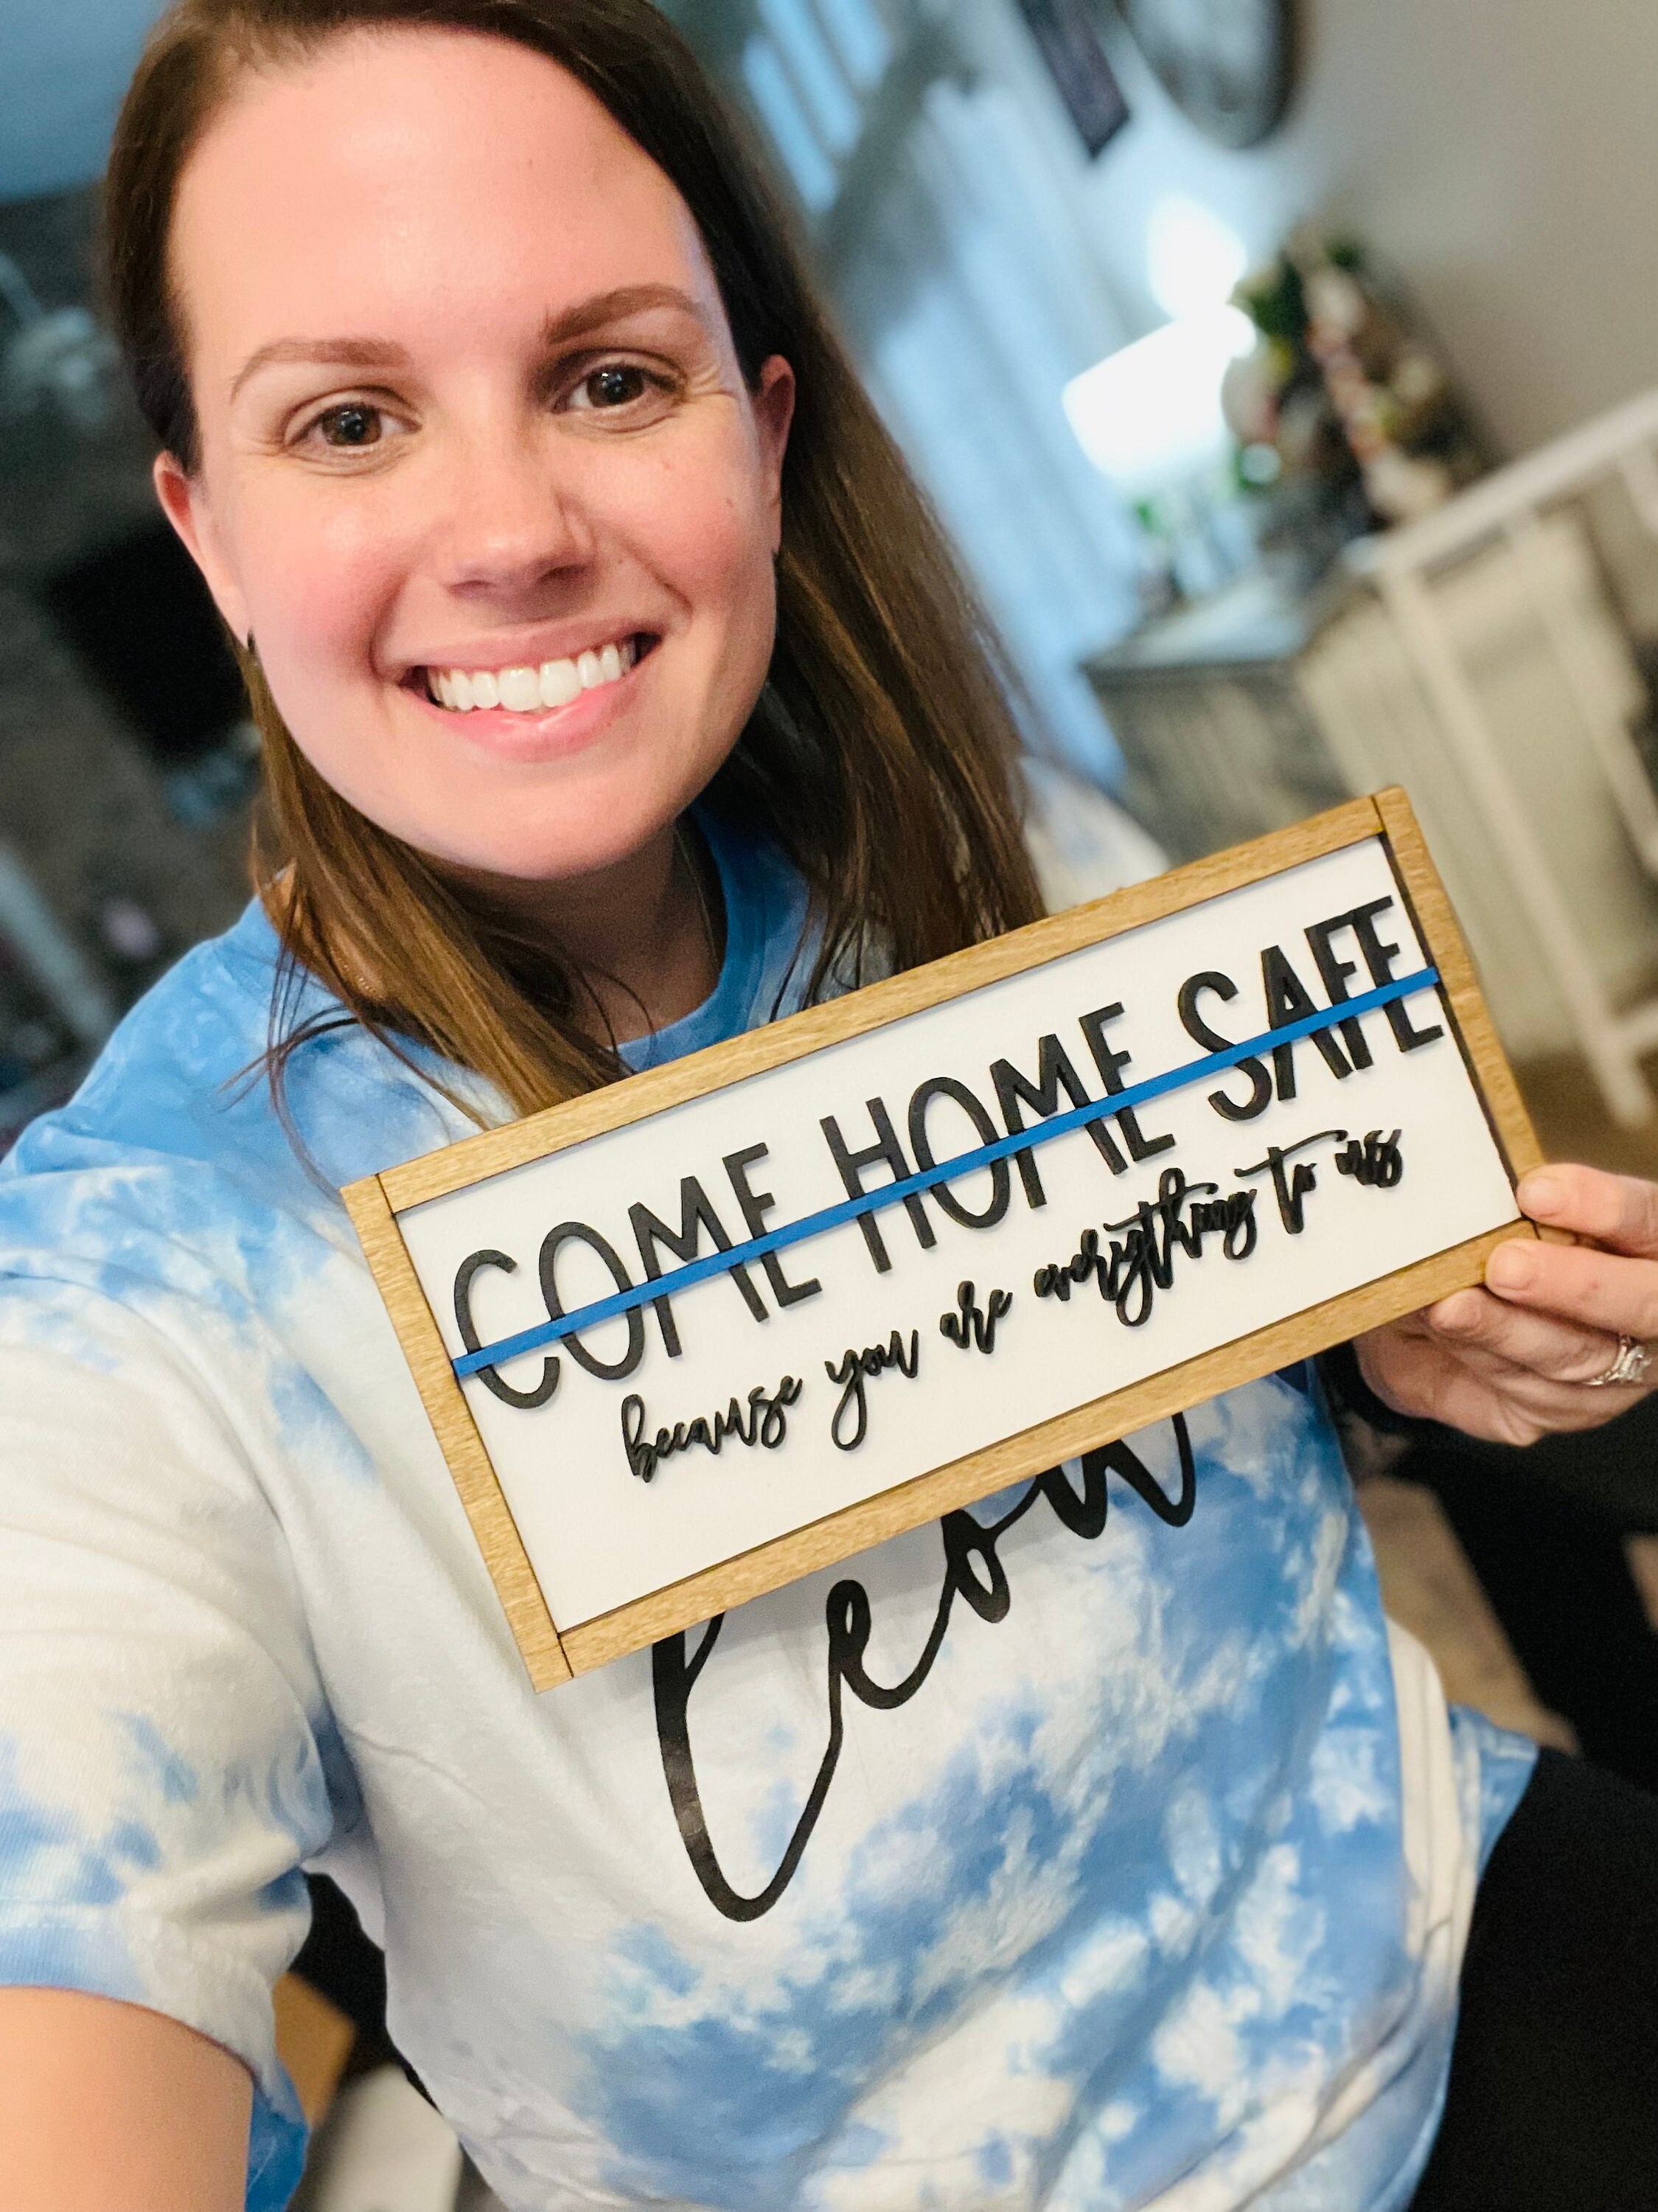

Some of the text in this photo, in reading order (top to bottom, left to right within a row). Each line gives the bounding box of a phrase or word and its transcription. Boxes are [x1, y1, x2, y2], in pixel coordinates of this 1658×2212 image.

[453, 894, 1445, 1409] COME HOME SAFE
[621, 1128, 1402, 1484] because you are everything to us
